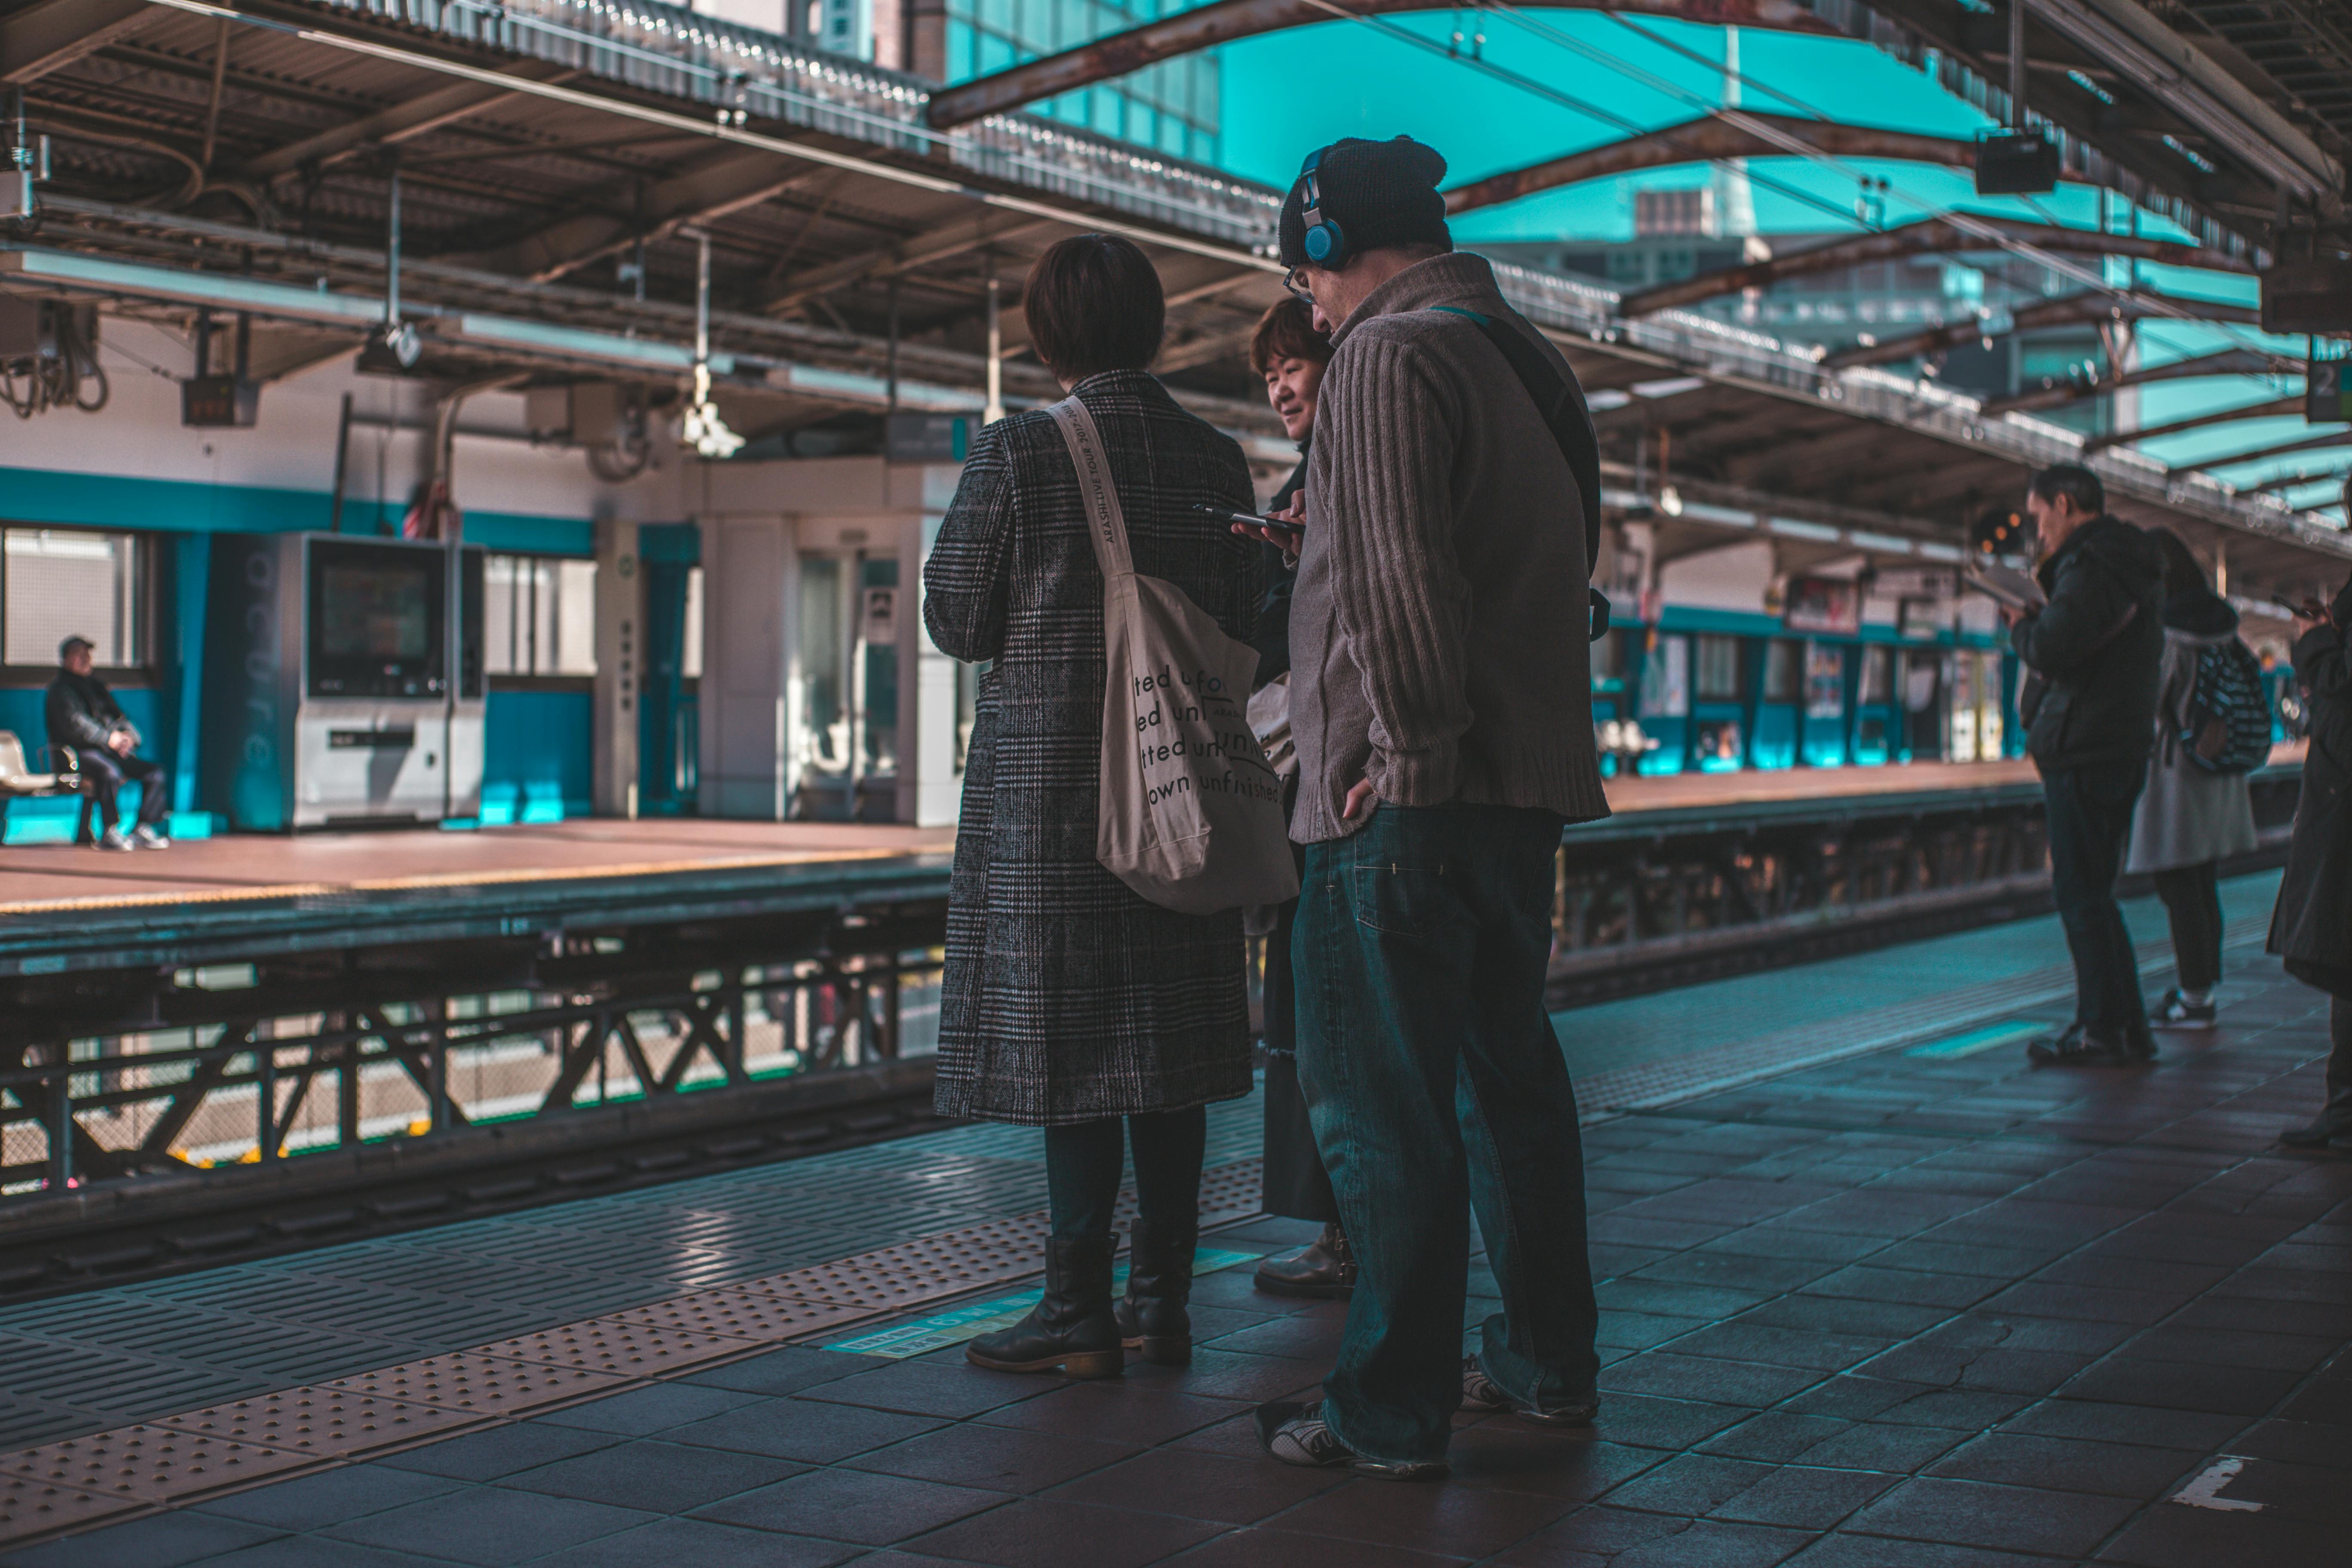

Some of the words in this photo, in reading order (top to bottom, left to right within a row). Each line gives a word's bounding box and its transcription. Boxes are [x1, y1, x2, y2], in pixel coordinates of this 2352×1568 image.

[1084, 447, 1098, 475] TOUR
[1093, 478, 1105, 501] LIVE
[1098, 503, 1114, 543] ARASHI
[1135, 665, 1170, 696] ted
[1148, 776, 1189, 805] own
